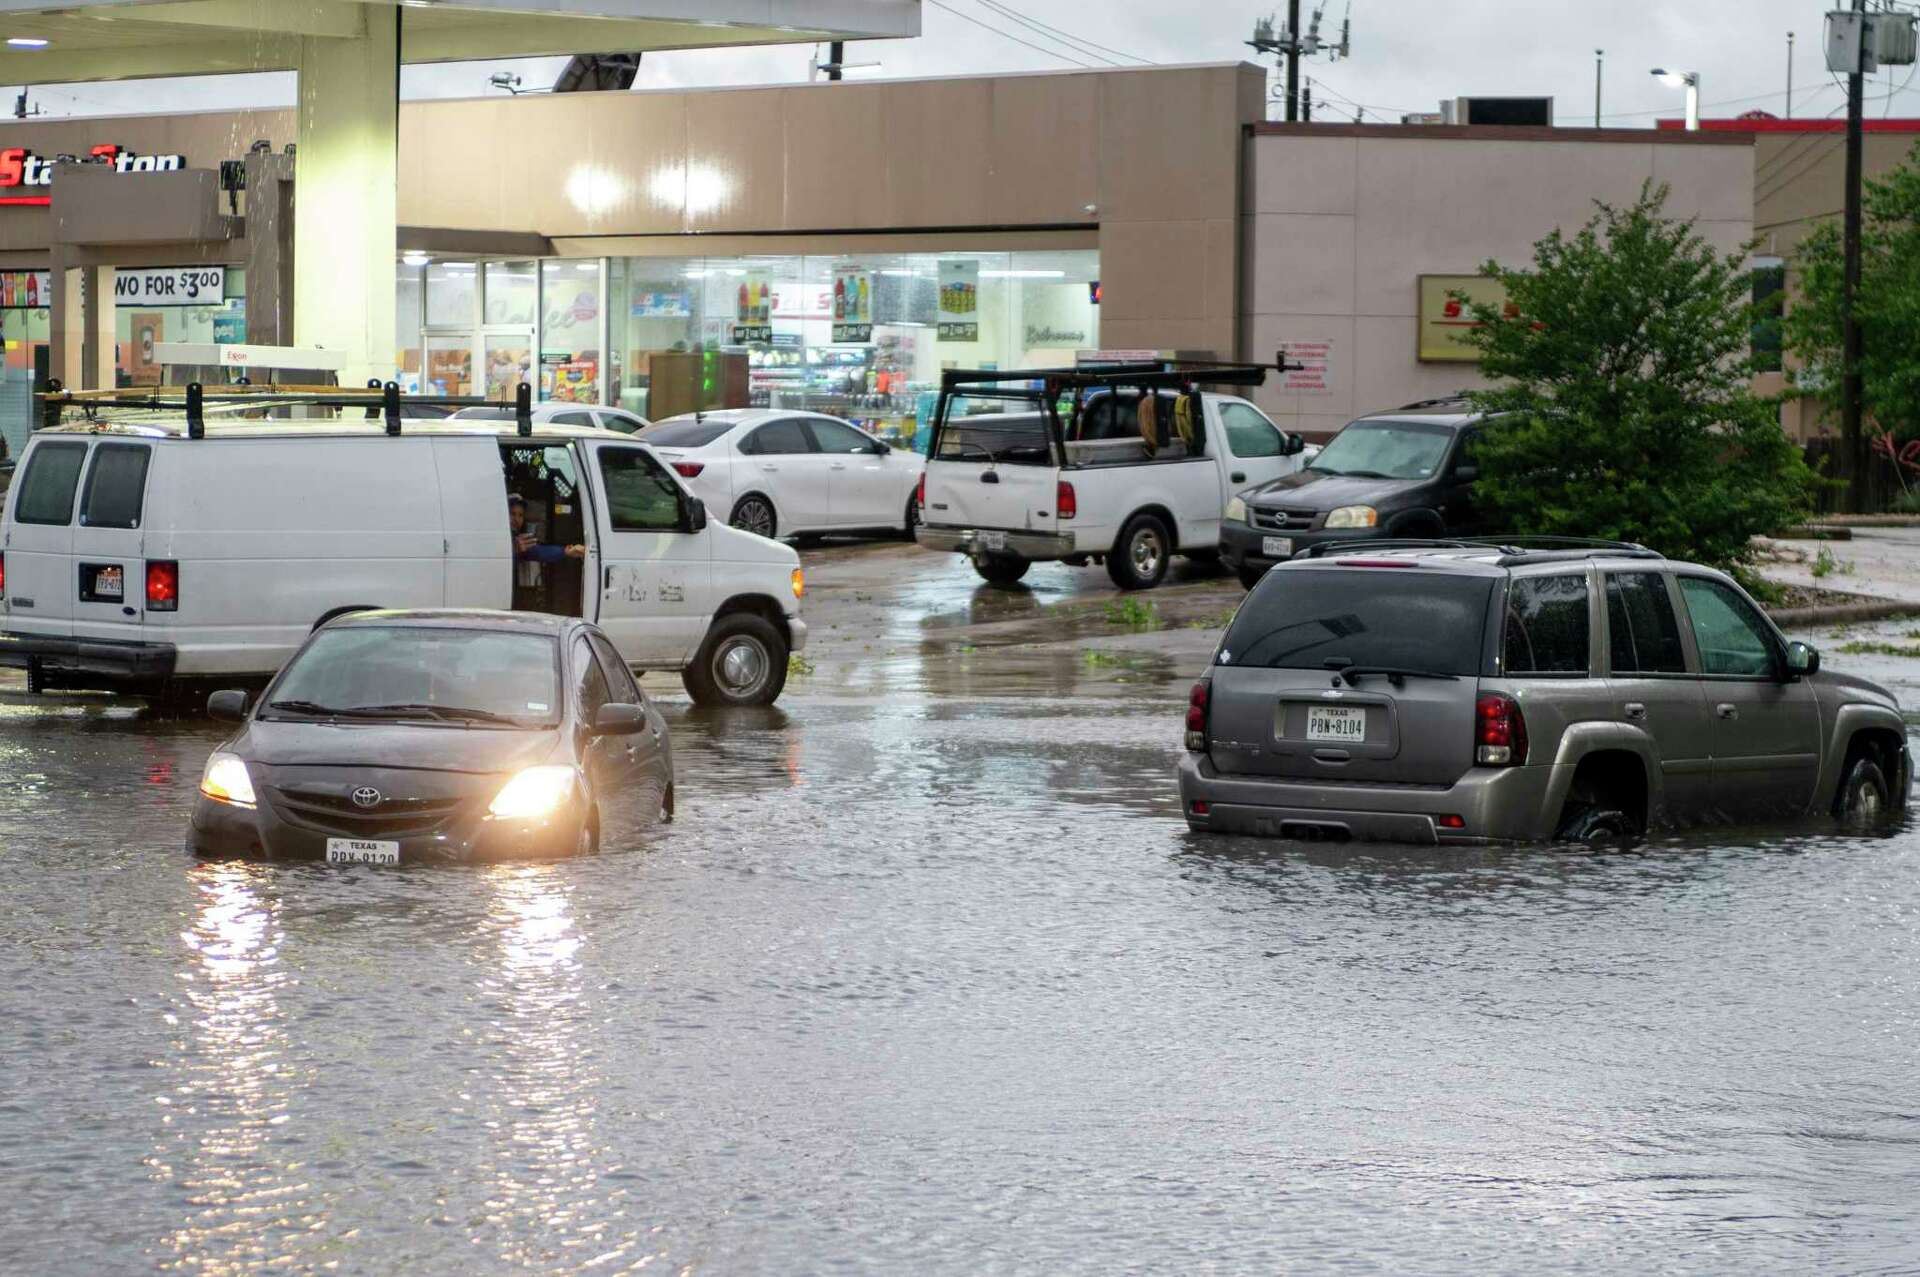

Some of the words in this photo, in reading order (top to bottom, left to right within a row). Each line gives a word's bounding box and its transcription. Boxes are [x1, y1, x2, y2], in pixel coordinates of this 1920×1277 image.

[0, 147, 70, 187] Sta
[145, 276, 176, 296] FOR
[350, 842, 377, 850] TEXAS
